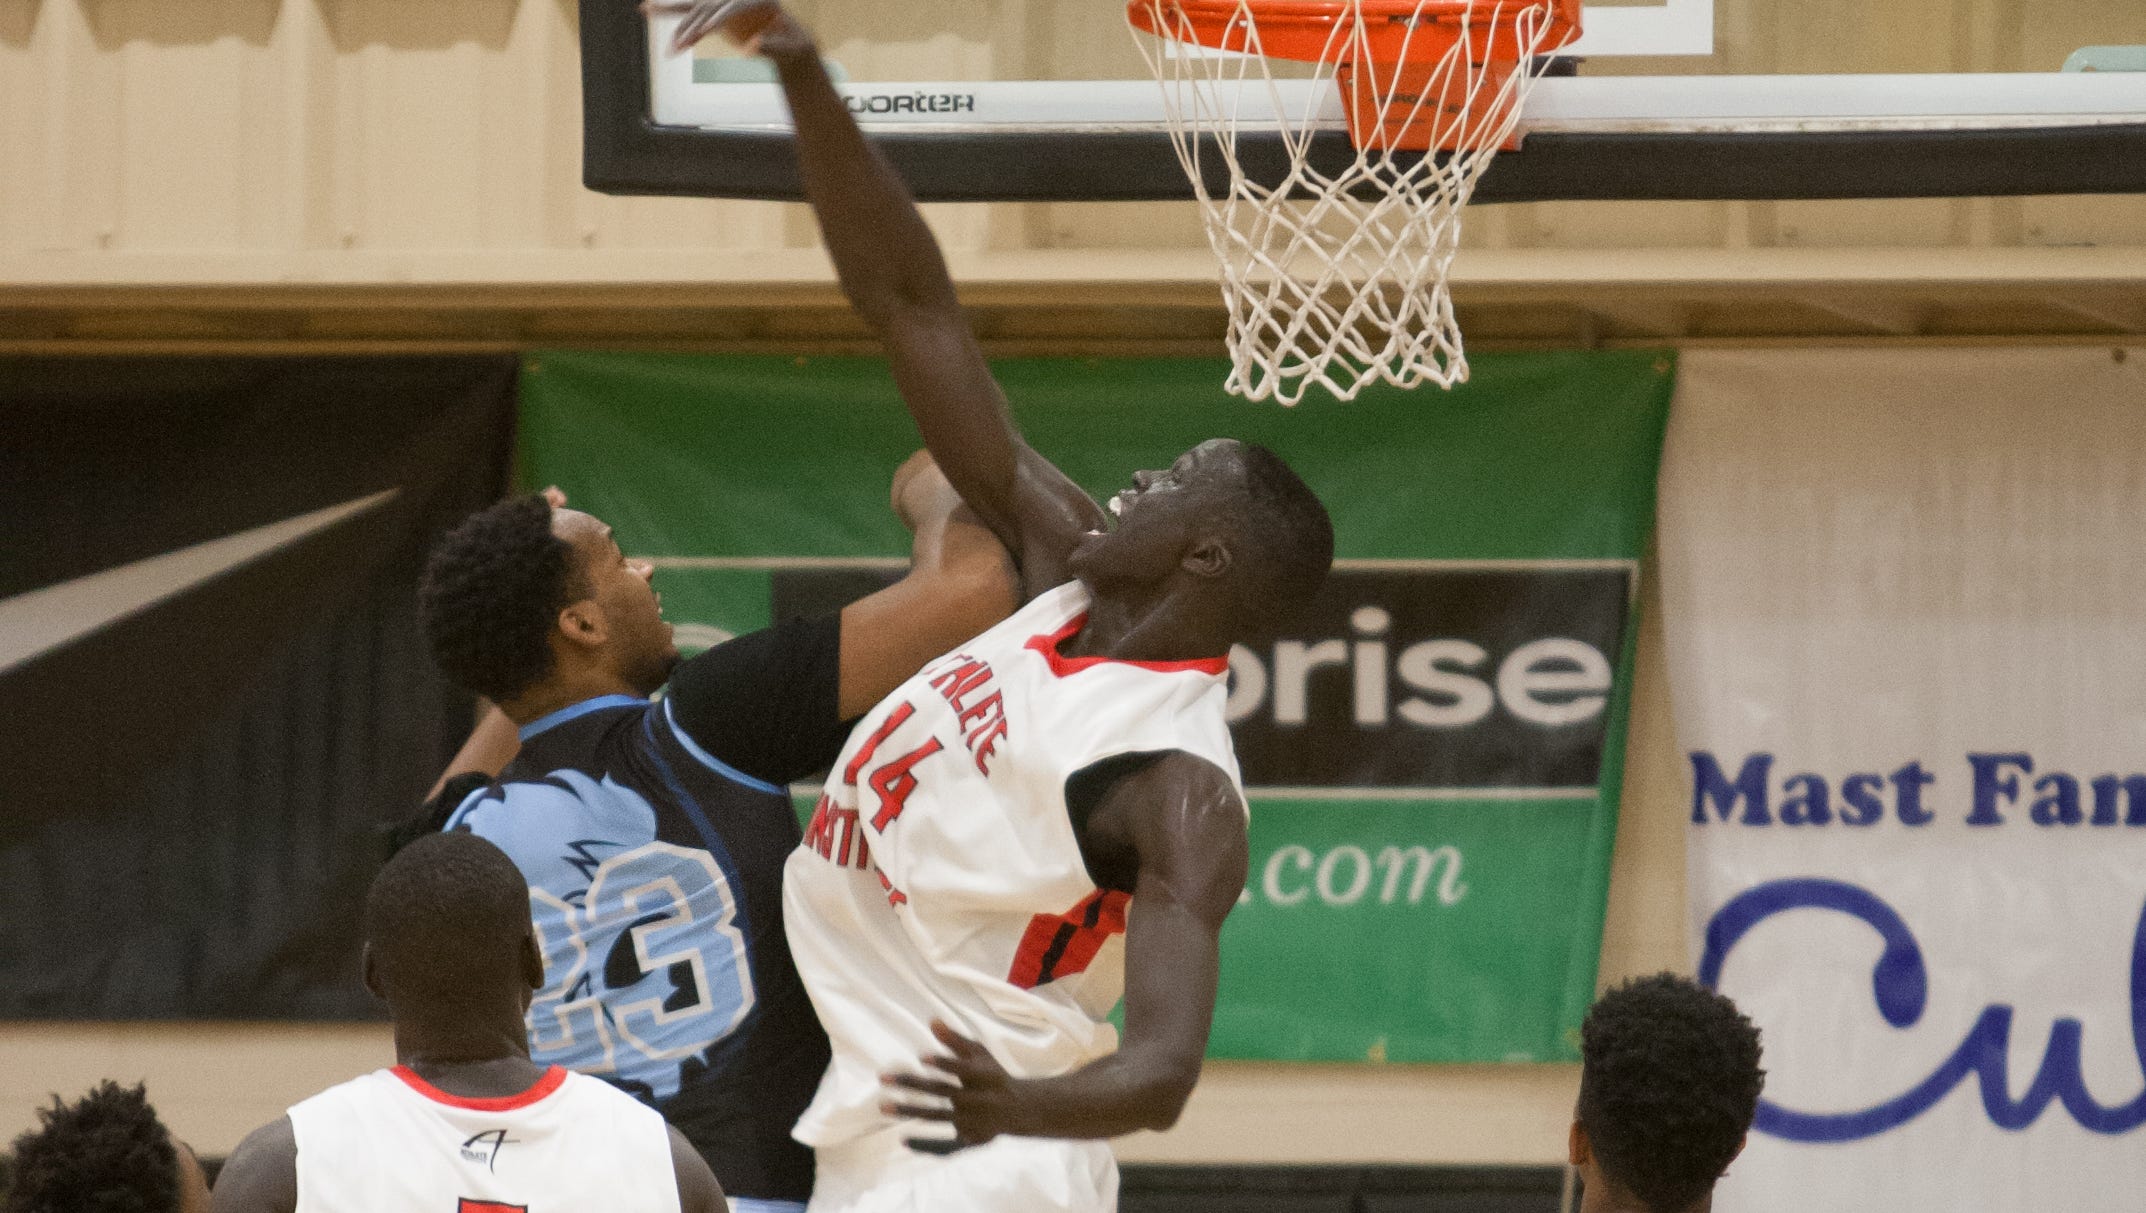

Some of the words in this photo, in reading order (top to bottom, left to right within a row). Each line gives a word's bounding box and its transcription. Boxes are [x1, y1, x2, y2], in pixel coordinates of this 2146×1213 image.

[843, 700, 945, 835] 14
[1690, 752, 1936, 828] Mast
[1697, 876, 2146, 1144] Cu
